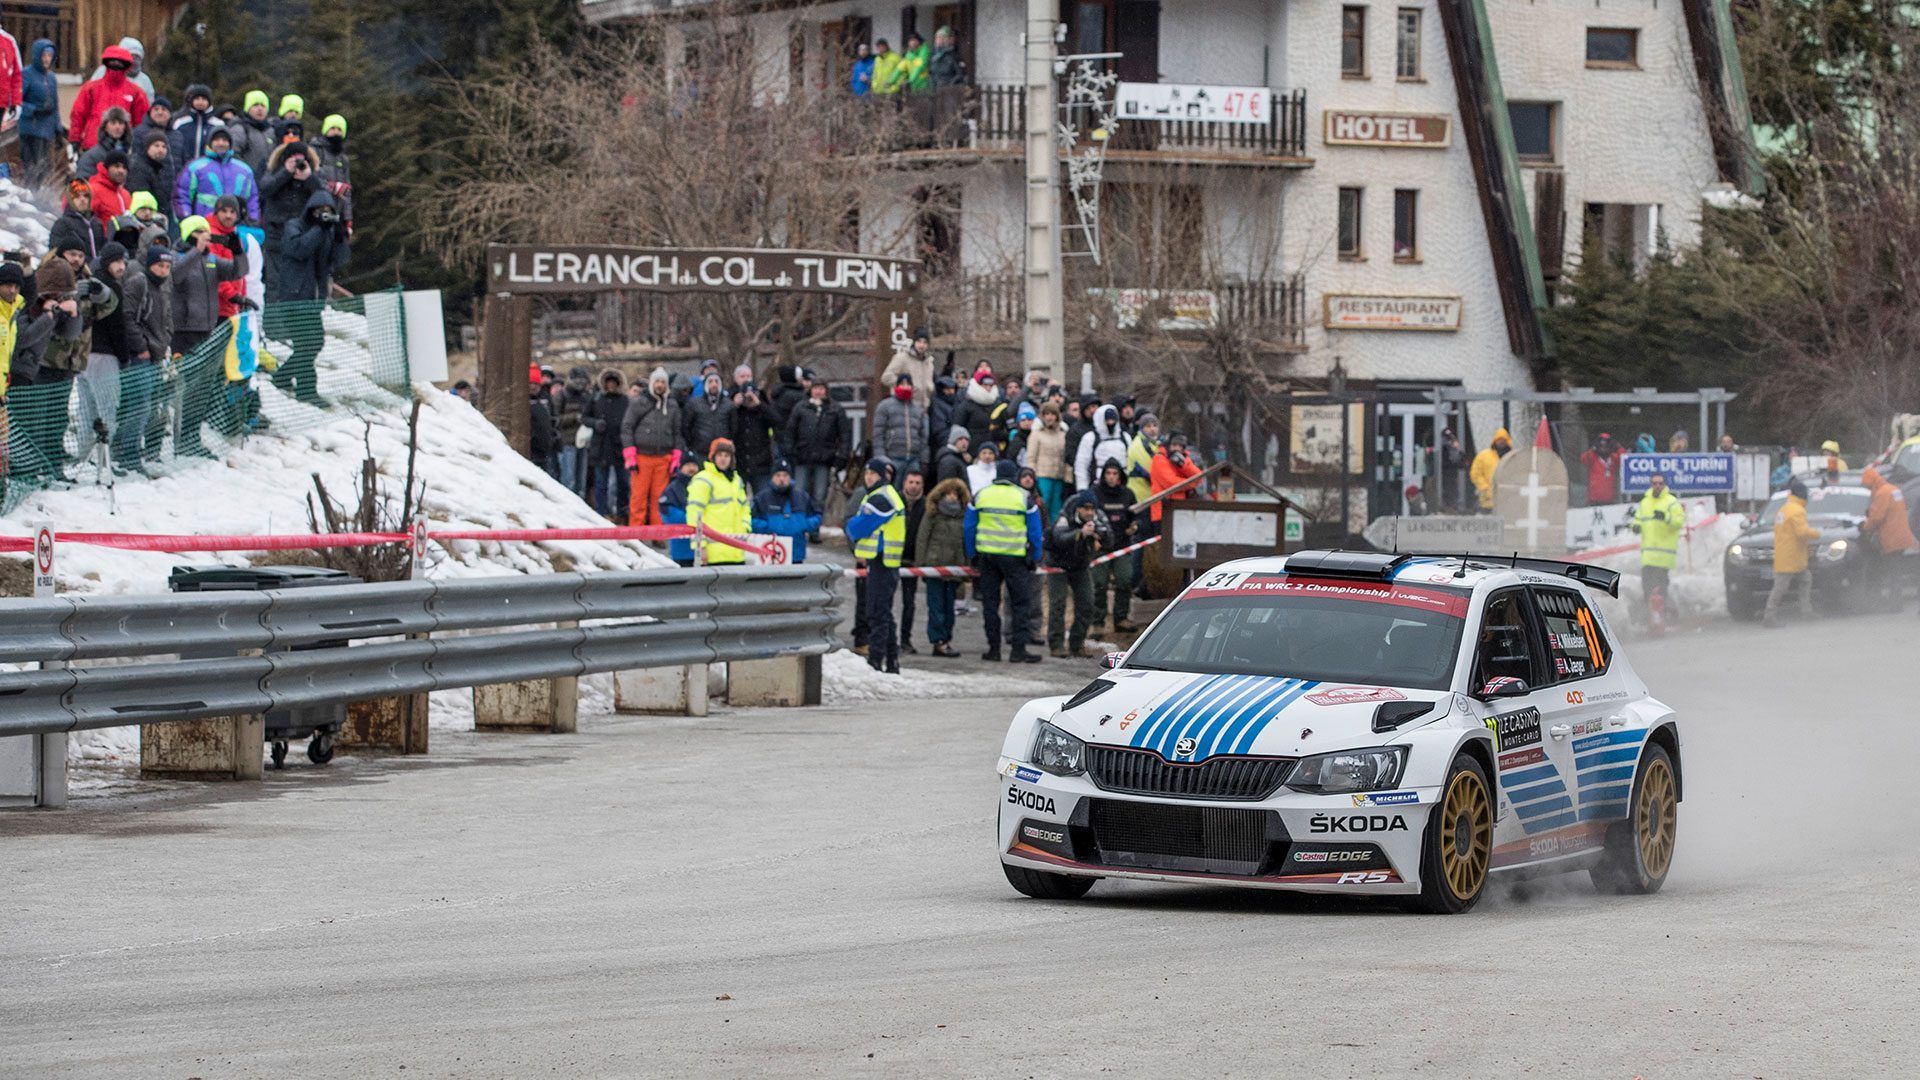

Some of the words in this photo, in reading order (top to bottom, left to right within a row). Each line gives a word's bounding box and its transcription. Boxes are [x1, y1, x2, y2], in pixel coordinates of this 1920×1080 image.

[1223, 93, 1244, 117] 47
[1335, 115, 1424, 140] HOTEL
[701, 256, 772, 287] COL
[1339, 301, 1452, 314] RESTAURANT
[1629, 458, 1657, 472] COL
[1660, 458, 1678, 472] DE
[1682, 458, 1728, 472] TURINI
[1206, 572, 1241, 588] 31
[1265, 583, 1292, 591] WRC
[1306, 584, 1390, 598] Championship
[1510, 710, 1540, 732] CASINO
[1008, 784, 1056, 815] ŠKODA
[1375, 793, 1418, 802] MICHELIN
[1310, 812, 1408, 833] ŠKODA
[1040, 830, 1063, 843] EDGE
[1302, 852, 1327, 861] Castrol
[1328, 851, 1373, 862] EDGE
[1337, 870, 1391, 884] R5
